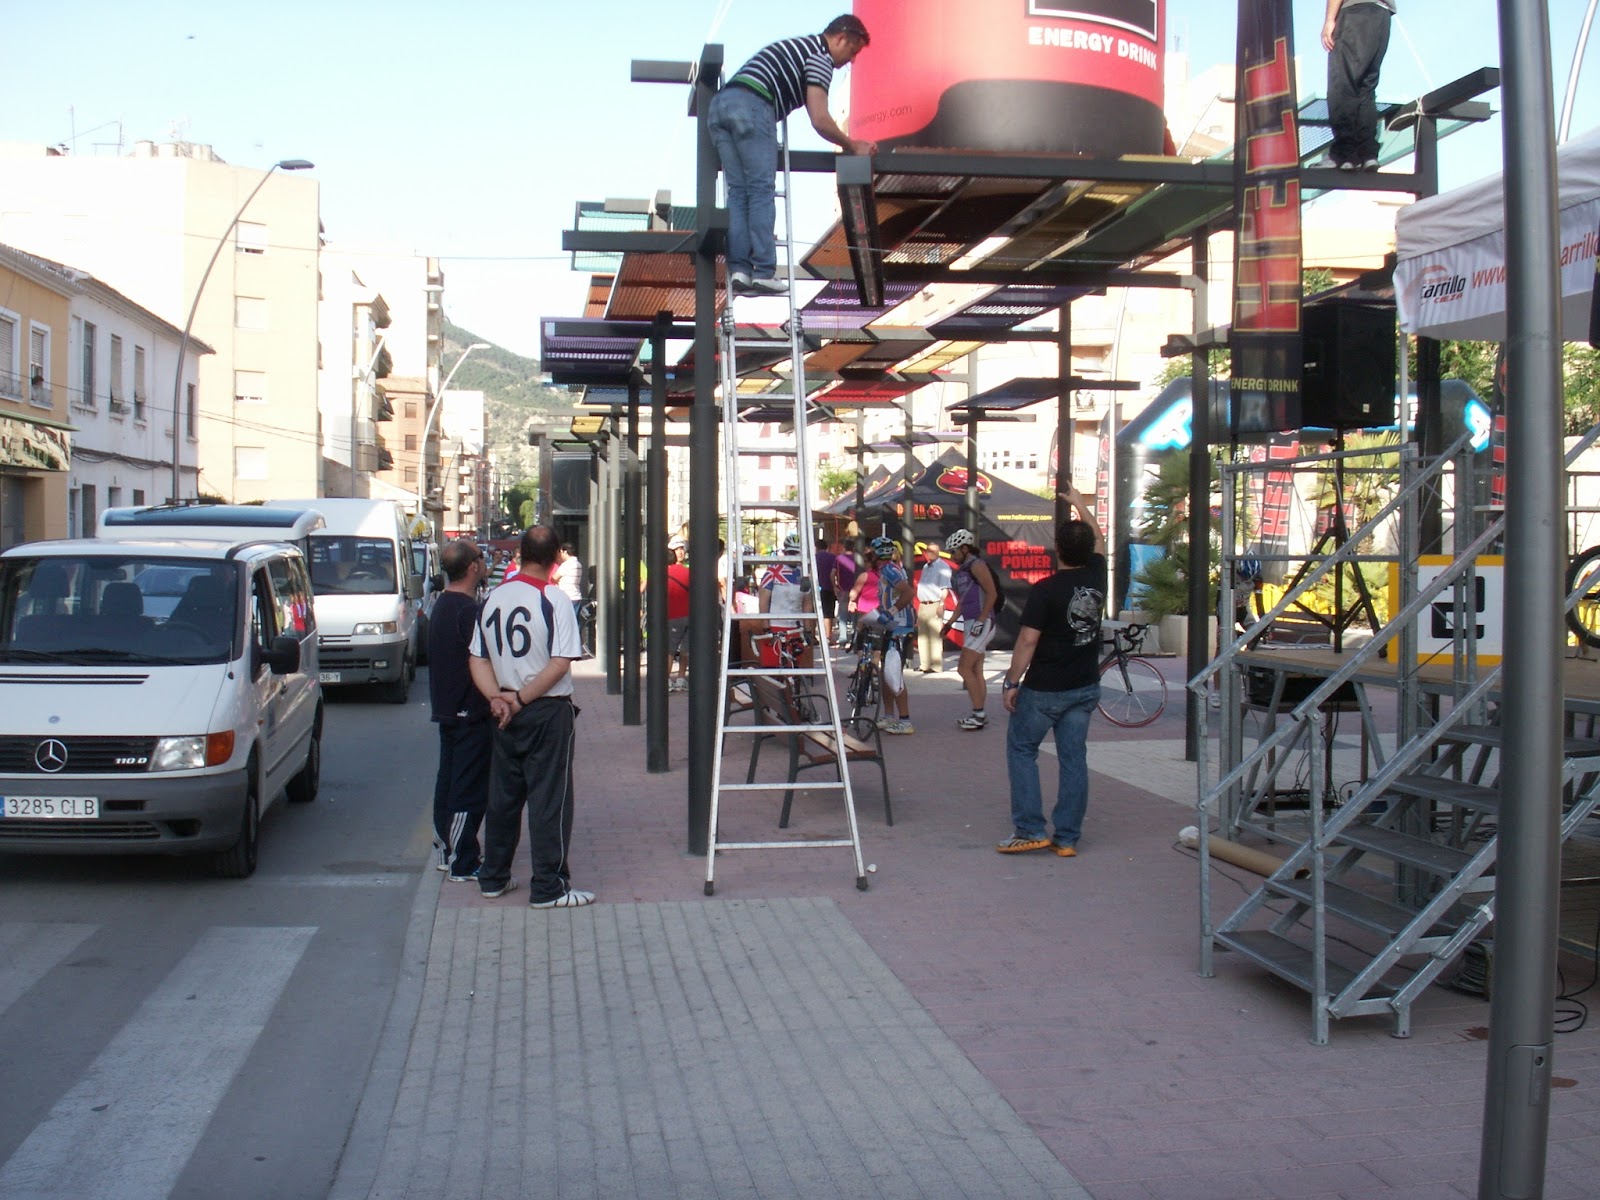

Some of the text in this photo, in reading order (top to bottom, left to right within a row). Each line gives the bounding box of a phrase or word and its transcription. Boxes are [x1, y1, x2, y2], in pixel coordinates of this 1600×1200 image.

[1028, 26, 1157, 71] ENERGY DRINK
[1233, 36, 1300, 333] HELL
[1231, 378, 1299, 392] ENERGY DRINK
[986, 540, 1028, 555] GIVES
[1001, 555, 1052, 570] POWER
[485, 605, 532, 658] 16
[114, 757, 136, 765] 110
[9, 798, 95, 816] 3285 CLB
